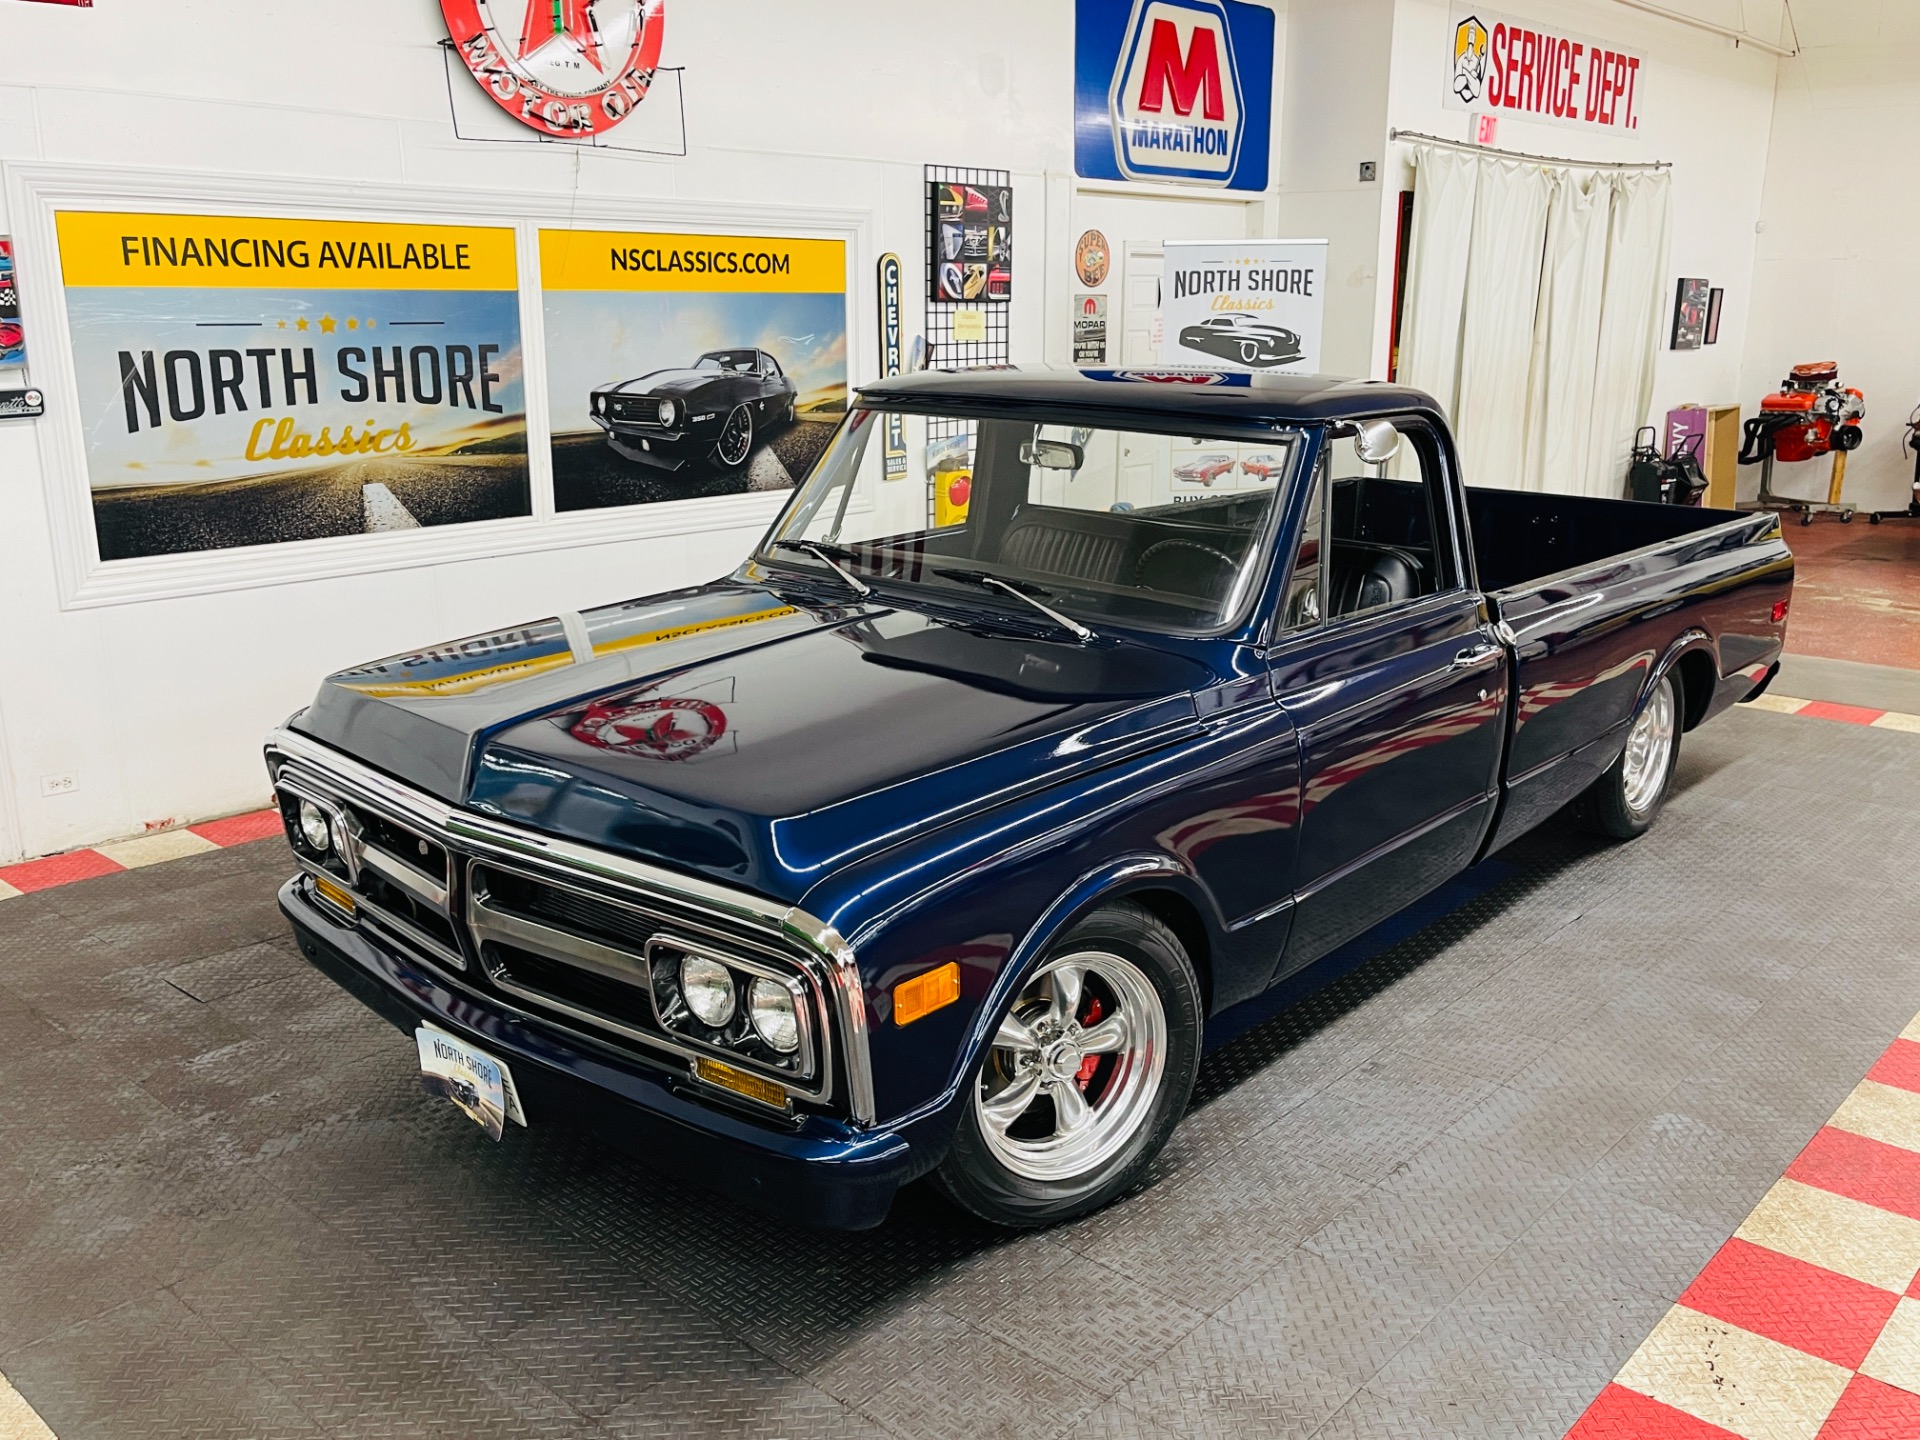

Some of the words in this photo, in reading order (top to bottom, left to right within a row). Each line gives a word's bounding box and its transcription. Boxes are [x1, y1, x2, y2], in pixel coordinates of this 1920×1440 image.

[462, 33, 594, 133] MOTOR
[601, 67, 656, 121] OIL
[1137, 18, 1224, 122] M
[1488, 22, 1583, 119] SERVICE
[1585, 47, 1639, 129] DEPT.
[1132, 118, 1228, 156] MARATHON
[121, 236, 310, 268] FINANCING
[318, 241, 471, 270] AVAILABLE
[611, 248, 790, 275] NSCLASSICS.COM
[1079, 232, 1106, 256] SUPER
[1083, 264, 1105, 285] BEE
[1174, 269, 1241, 299] NORTH
[1248, 269, 1314, 297] SHORE
[1211, 294, 1275, 312] Classics
[1074, 320, 1106, 329] MOPAR
[118, 346, 318, 434] NORTH
[337, 343, 504, 414] SHORE
[245, 416, 417, 462] Classics
[433, 1038, 465, 1066] NORTH
[466, 1055, 493, 1090] SHORE
